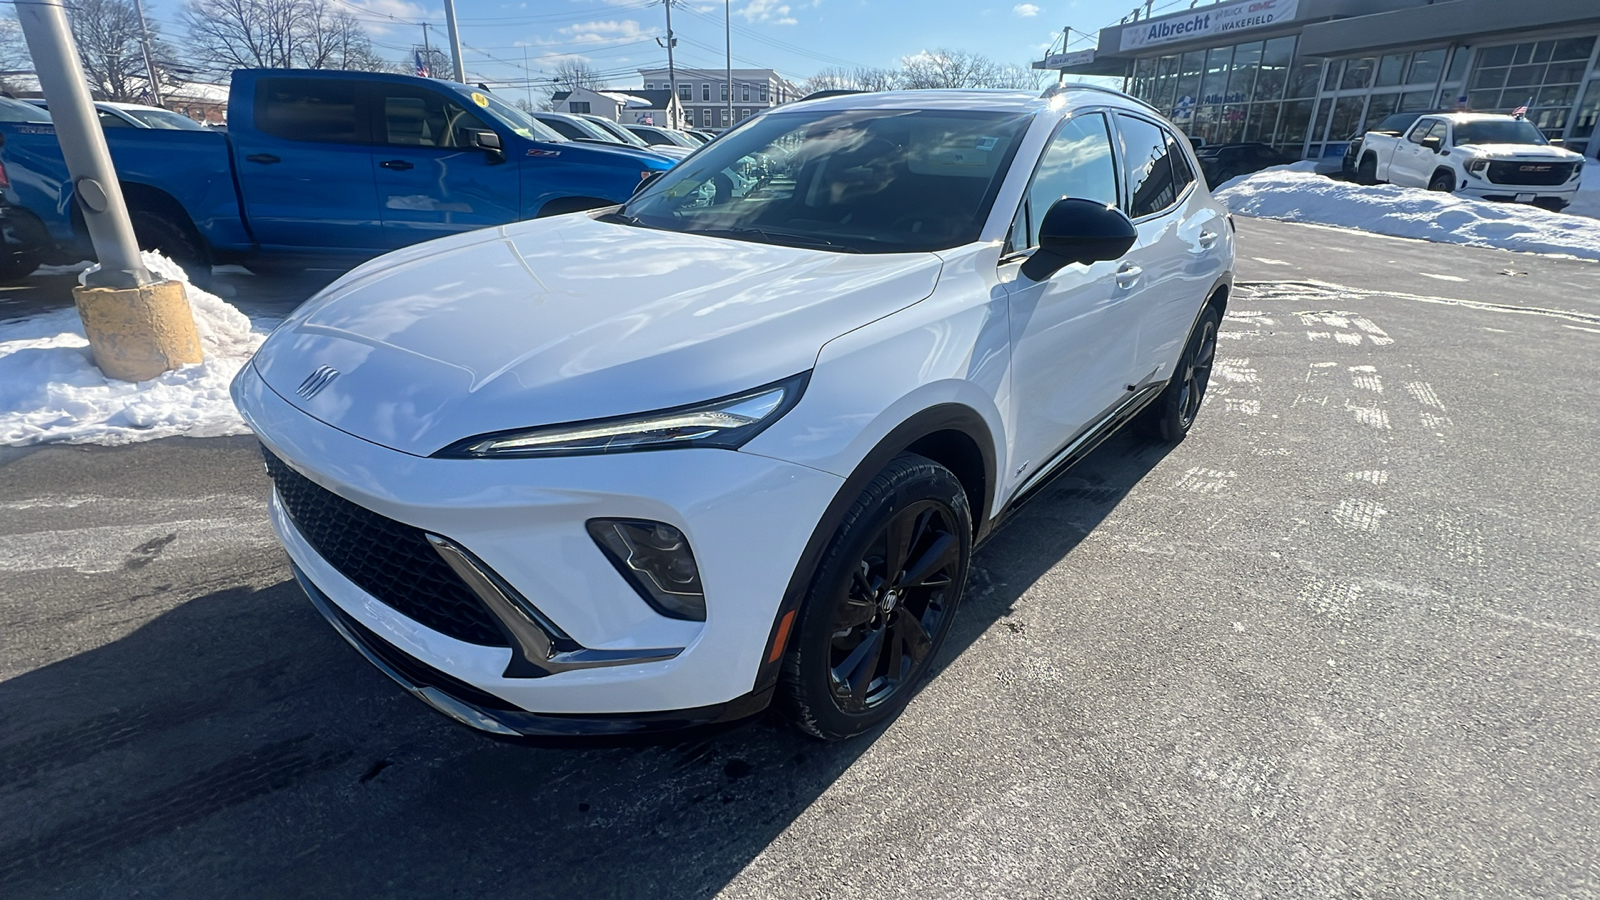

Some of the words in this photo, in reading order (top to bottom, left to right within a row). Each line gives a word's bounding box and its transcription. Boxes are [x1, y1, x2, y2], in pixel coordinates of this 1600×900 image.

[1248, 0, 1277, 13] GMC
[1148, 13, 1210, 40] Albrecht
[1221, 14, 1273, 31] WAKEFIELD
